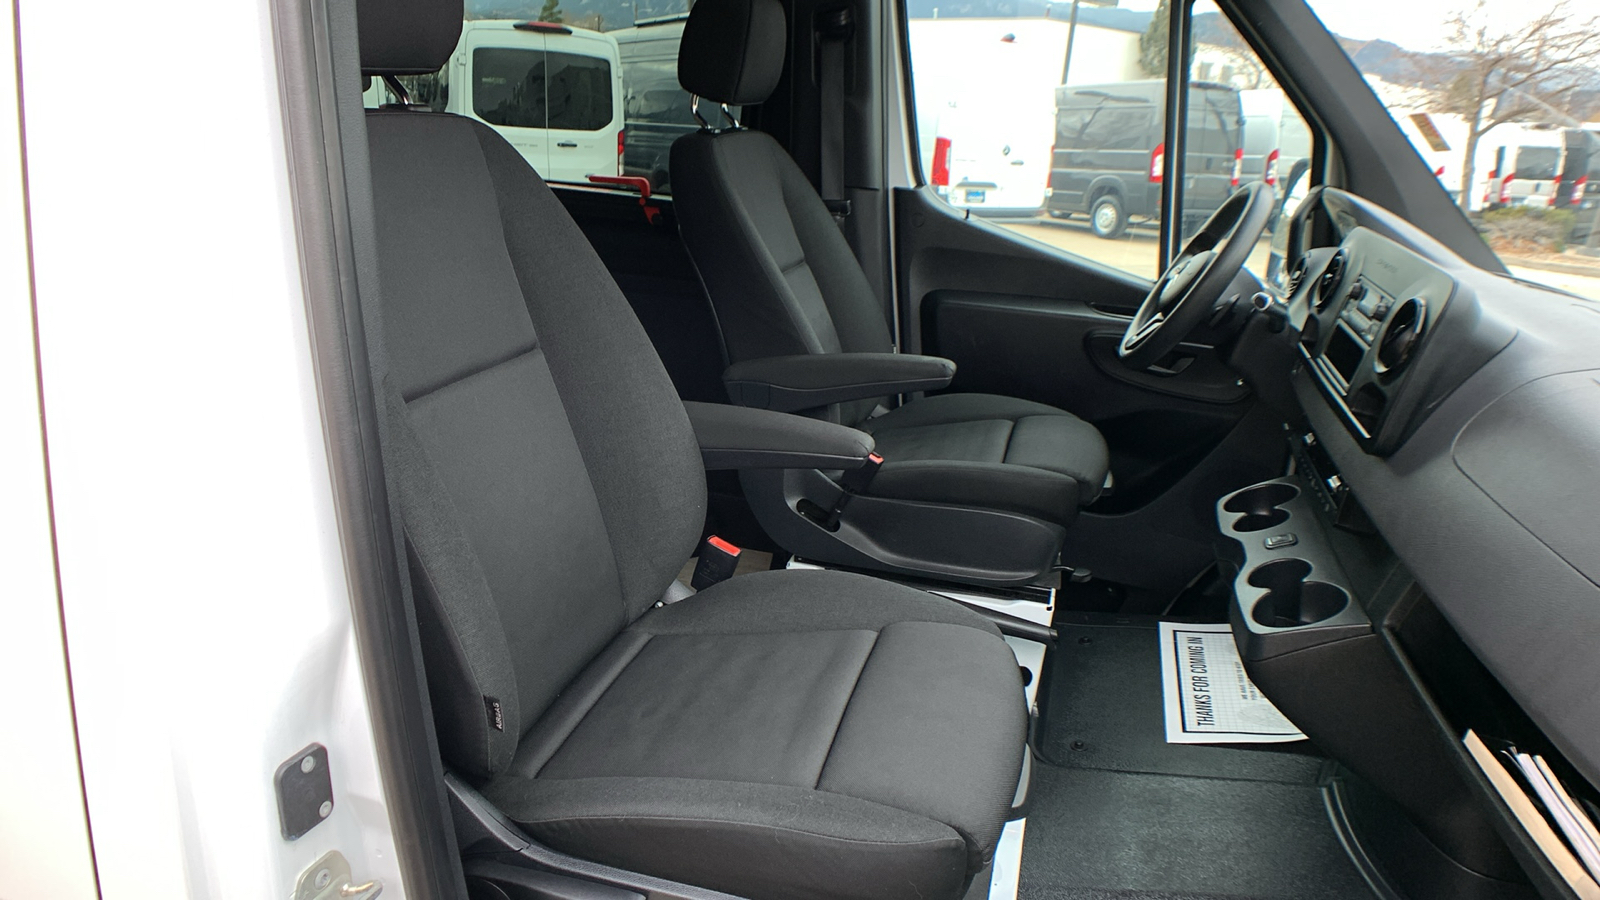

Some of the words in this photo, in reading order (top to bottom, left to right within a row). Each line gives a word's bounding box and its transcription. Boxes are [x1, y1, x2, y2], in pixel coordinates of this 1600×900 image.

[1187, 636, 1203, 644] IN
[1188, 645, 1208, 674] COMING
[1192, 675, 1210, 693] FOR
[493, 702, 502, 729] AIRBAG
[1194, 694, 1215, 726] THANKS
